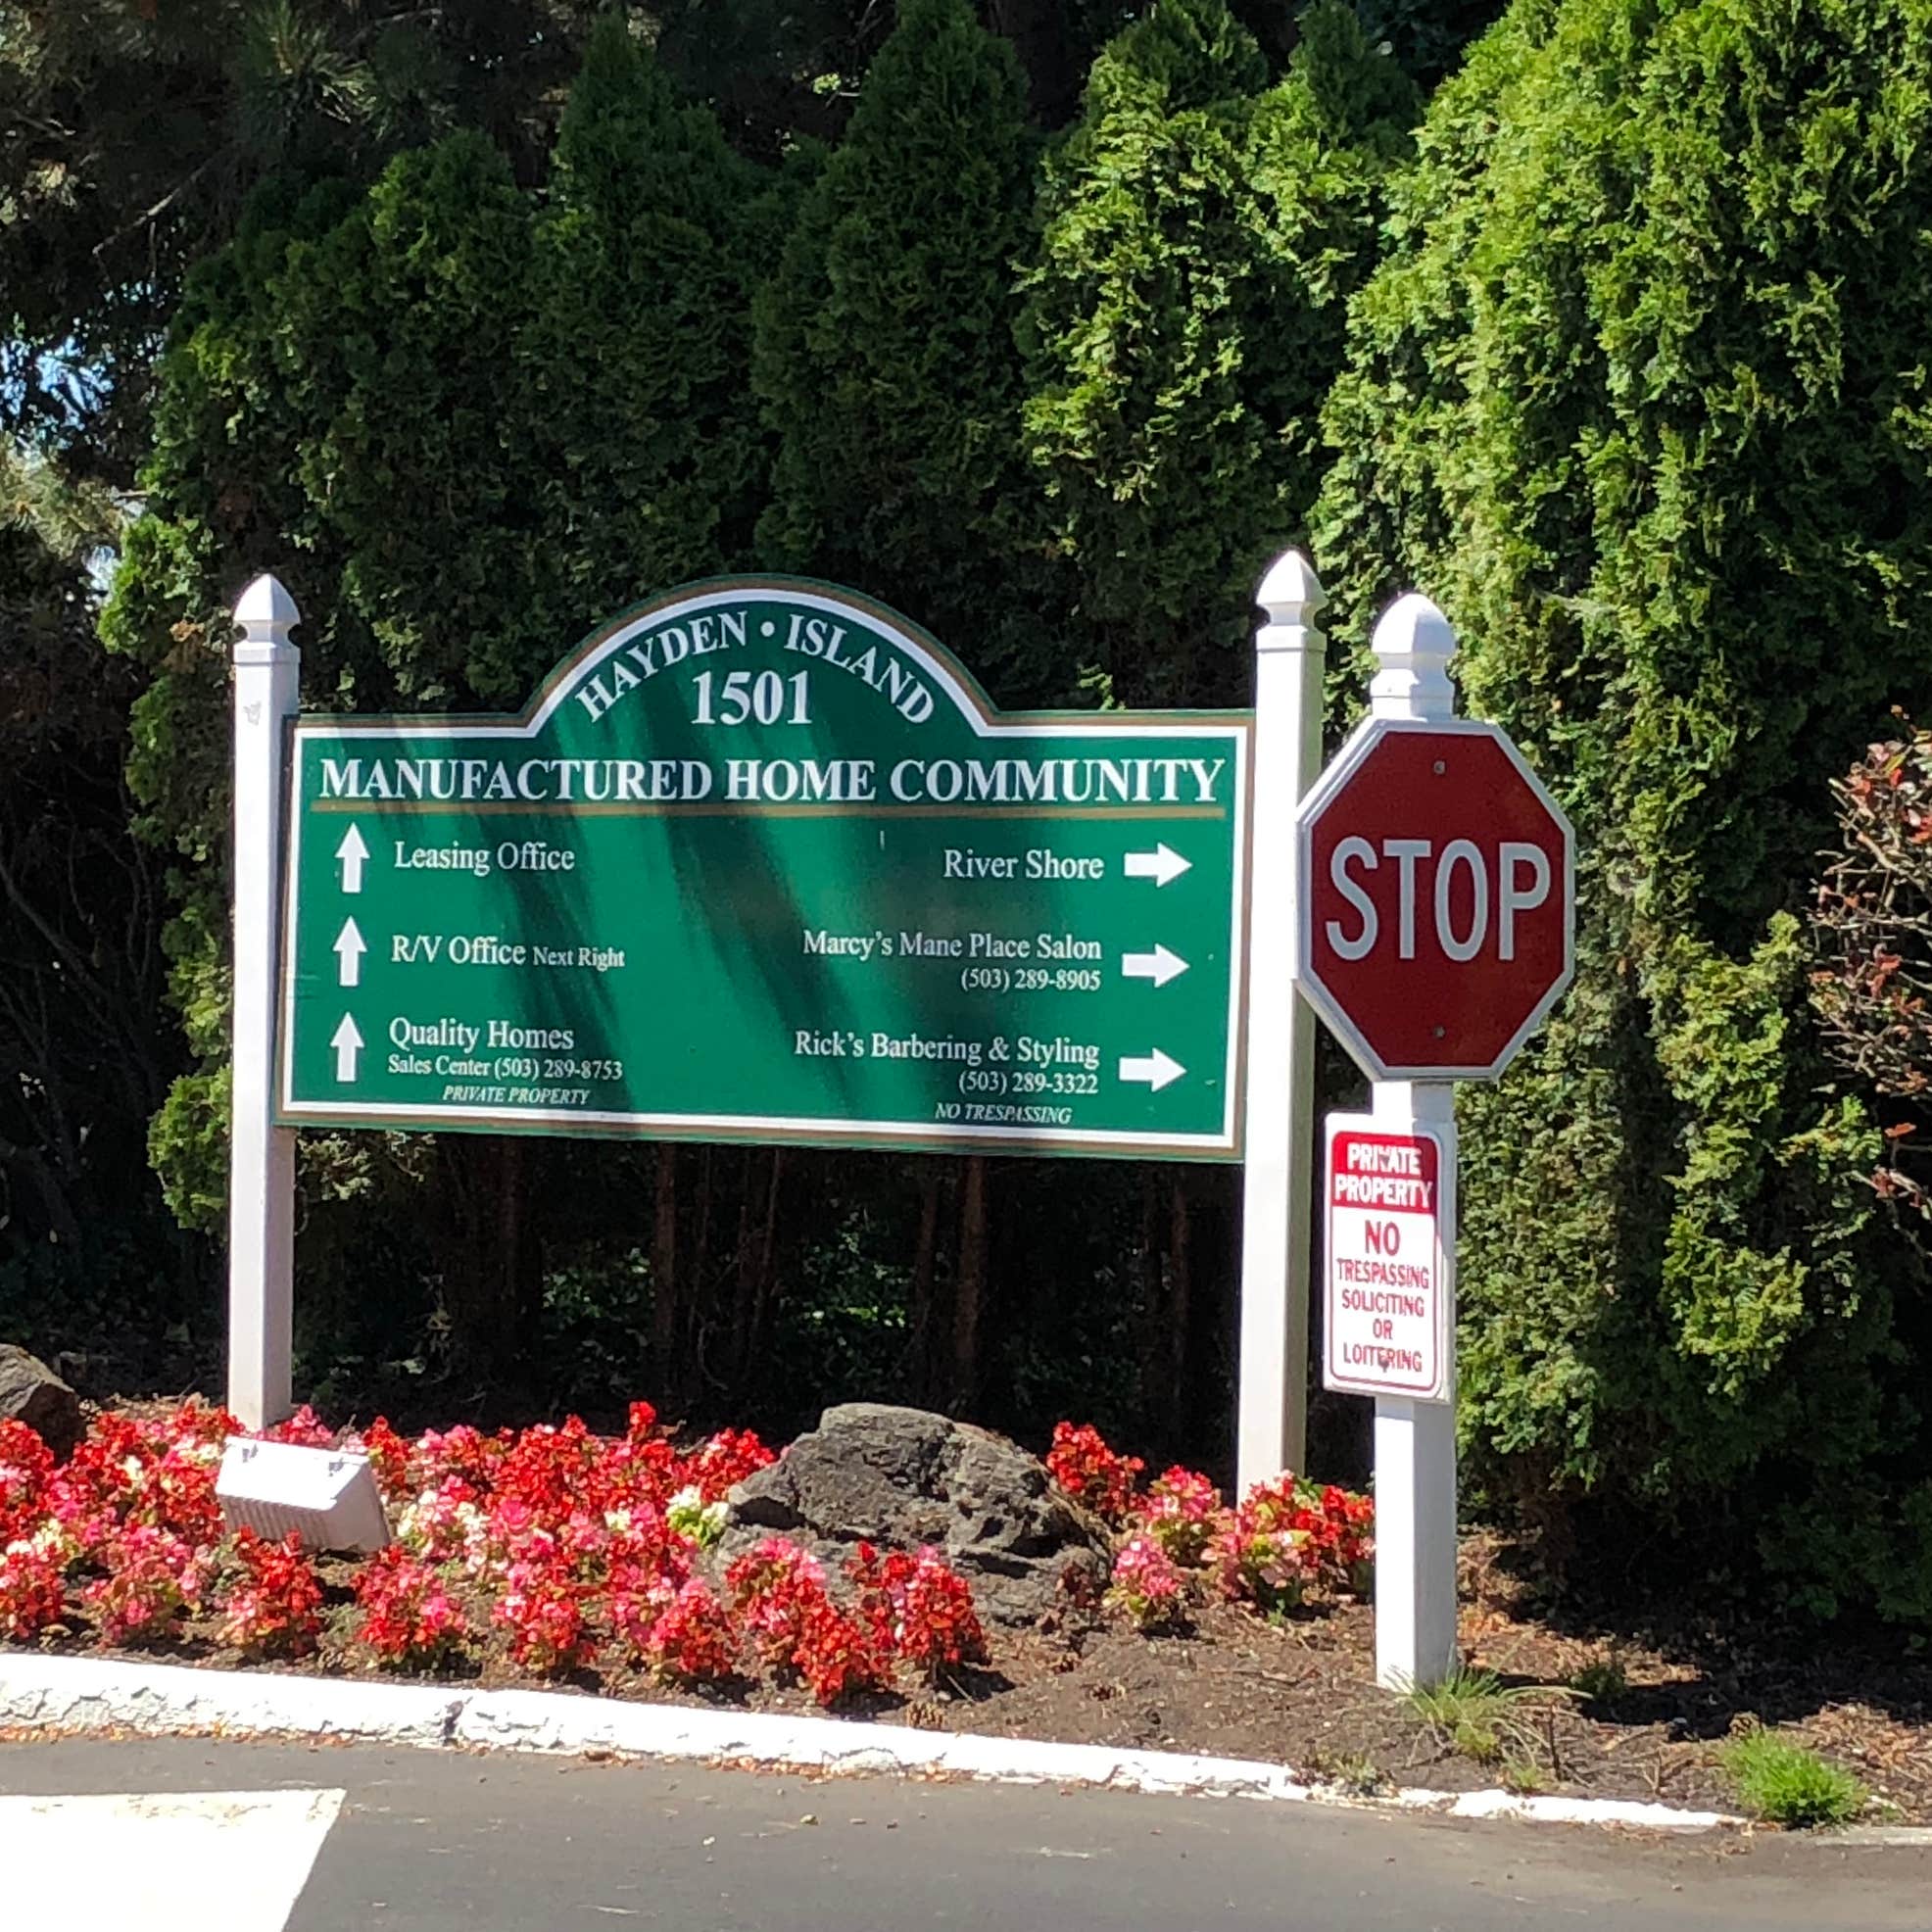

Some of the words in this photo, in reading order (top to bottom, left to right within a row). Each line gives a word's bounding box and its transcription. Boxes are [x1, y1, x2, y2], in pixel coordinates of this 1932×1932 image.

[573, 609, 749, 723] HAYDEN
[784, 613, 934, 724] ISLAND
[691, 670, 812, 726] 1501
[319, 758, 712, 800] MANUFACTURED
[724, 759, 876, 801] HOME
[890, 758, 1226, 802] COMMUNITY
[394, 841, 490, 877] Leasing
[497, 842, 575, 871] Office
[942, 849, 1019, 878] River
[1025, 849, 1105, 880] Shore
[1326, 836, 1551, 961] STOP
[392, 935, 442, 963] R/V
[448, 937, 526, 965] Office
[533, 946, 573, 966] Next
[578, 946, 625, 971] Right
[802, 929, 893, 961] Marcy's
[898, 932, 962, 957] Mane
[969, 933, 1030, 958] Place
[1037, 934, 1102, 959] Salon
[960, 968, 1010, 992] (503)
[1015, 969, 1102, 991] 289-8905
[389, 1017, 480, 1052] Quality
[487, 1021, 574, 1049] Homes
[794, 1030, 865, 1058] Rick's
[871, 1032, 983, 1066] Barbering
[989, 1037, 1009, 1061] &
[1017, 1037, 1100, 1070] Styling
[388, 1054, 432, 1076] Sales
[435, 1055, 491, 1077] Center
[494, 1056, 539, 1080] (503)
[544, 1059, 623, 1081] 289-8753
[958, 1071, 1007, 1095] (503)
[1011, 1073, 1098, 1094] 289-3322
[443, 1086, 506, 1103] PRIVATE
[507, 1087, 590, 1105] PROPERTY
[935, 1103, 960, 1120] NO
[964, 1104, 1072, 1124] TRESPASSING
[1347, 1142, 1422, 1175] PRIVATE
[1334, 1173, 1432, 1208] PROPERTY
[1364, 1220, 1400, 1256] NO
[1336, 1258, 1429, 1289] TRESPASSING
[1342, 1288, 1425, 1318] SOLICITING
[1373, 1318, 1393, 1339] OR
[1343, 1342, 1423, 1372] LOITERING
